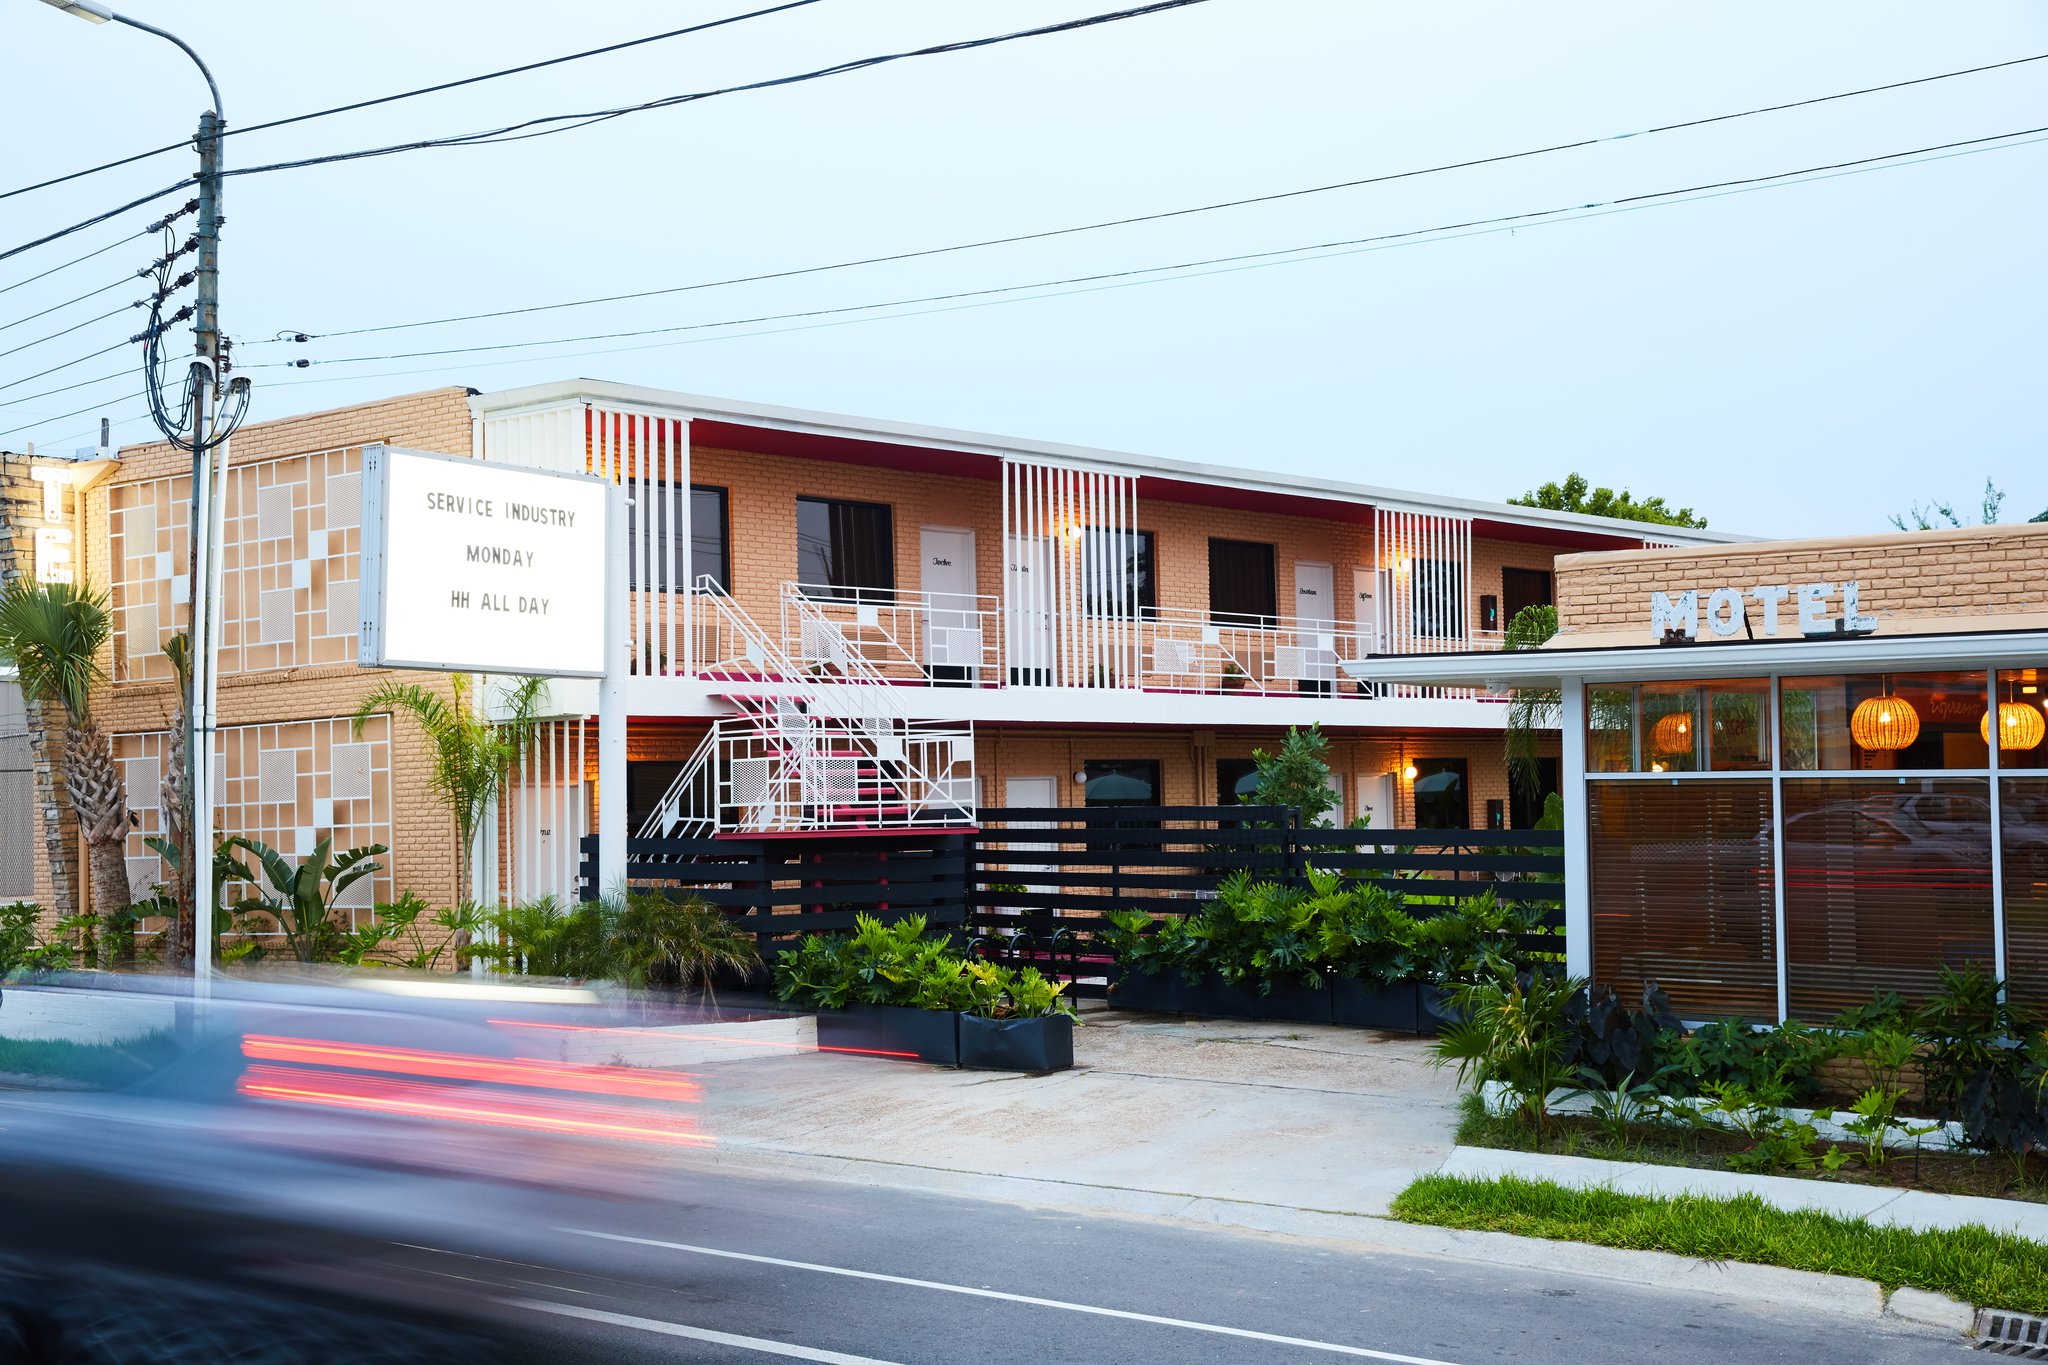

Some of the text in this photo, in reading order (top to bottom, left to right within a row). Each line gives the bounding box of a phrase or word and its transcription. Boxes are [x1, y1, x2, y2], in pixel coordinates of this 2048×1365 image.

[427, 492, 576, 527] SERVICE INDUSTRY
[31, 466, 74, 603] TE
[466, 544, 534, 568] MONDAY
[451, 590, 550, 615] HH ALL DAY
[1651, 581, 1880, 639] MOTEL
